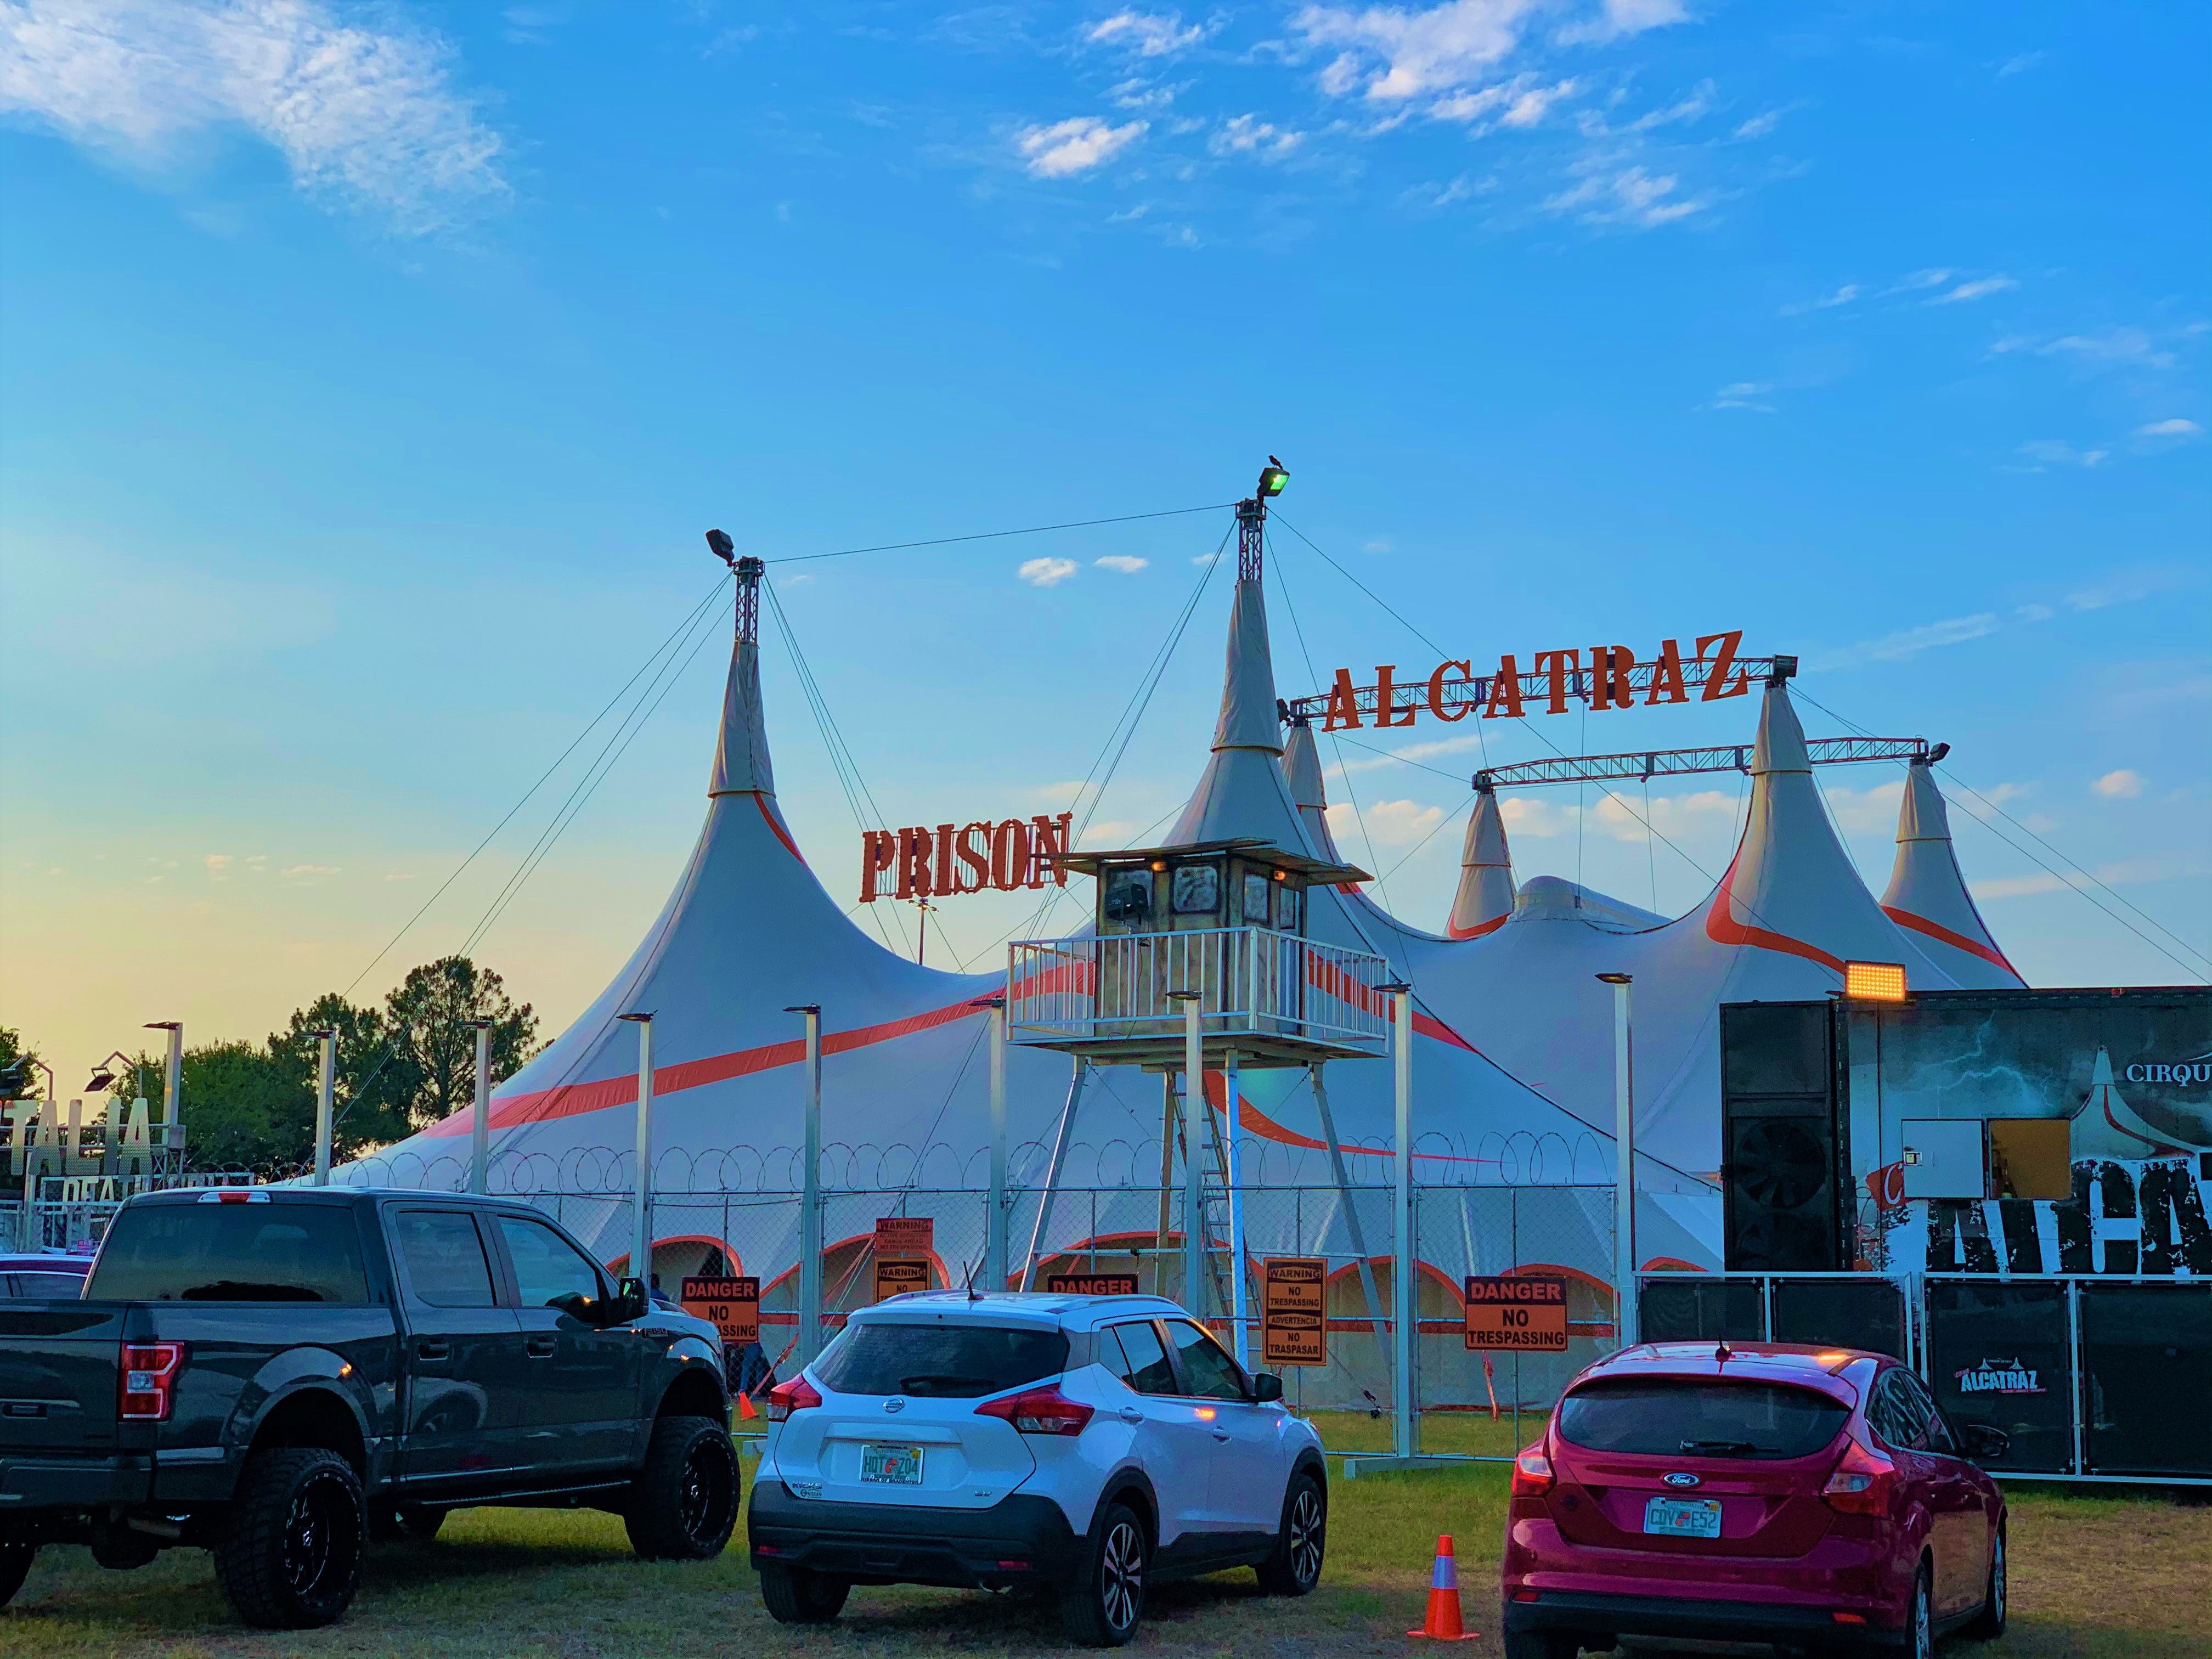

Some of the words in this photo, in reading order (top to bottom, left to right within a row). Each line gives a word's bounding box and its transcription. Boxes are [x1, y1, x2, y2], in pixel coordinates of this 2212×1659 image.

[1322, 630, 1748, 732] ALCATRAZ
[859, 811, 1073, 902] PRISON
[2126, 1064, 2212, 1087] CIRQU
[0, 1097, 153, 1176] TALIA
[881, 1220, 929, 1229] WARNING
[879, 1268, 926, 1277] WARNING
[1270, 1269, 1321, 1278] WARNING
[686, 1282, 754, 1297] DANGER
[896, 1285, 908, 1293] NO
[1053, 1280, 1133, 1295] DANGER
[1288, 1286, 1301, 1296] NO
[1470, 1283, 1562, 1300] DANGER
[1270, 1297, 1319, 1307] TRESPASSING
[708, 1305, 730, 1321] NO
[1271, 1316, 1317, 1325] ADVERTENCIA
[1502, 1309, 1529, 1327] NO
[1288, 1333, 1300, 1342] NO
[1468, 1330, 1564, 1345] TRESPASSING
[1269, 1344, 1319, 1355] TRASPASAR
[1961, 1370, 2038, 1392] ALCATRAZ
[1672, 1475, 1691, 1484] Ford
